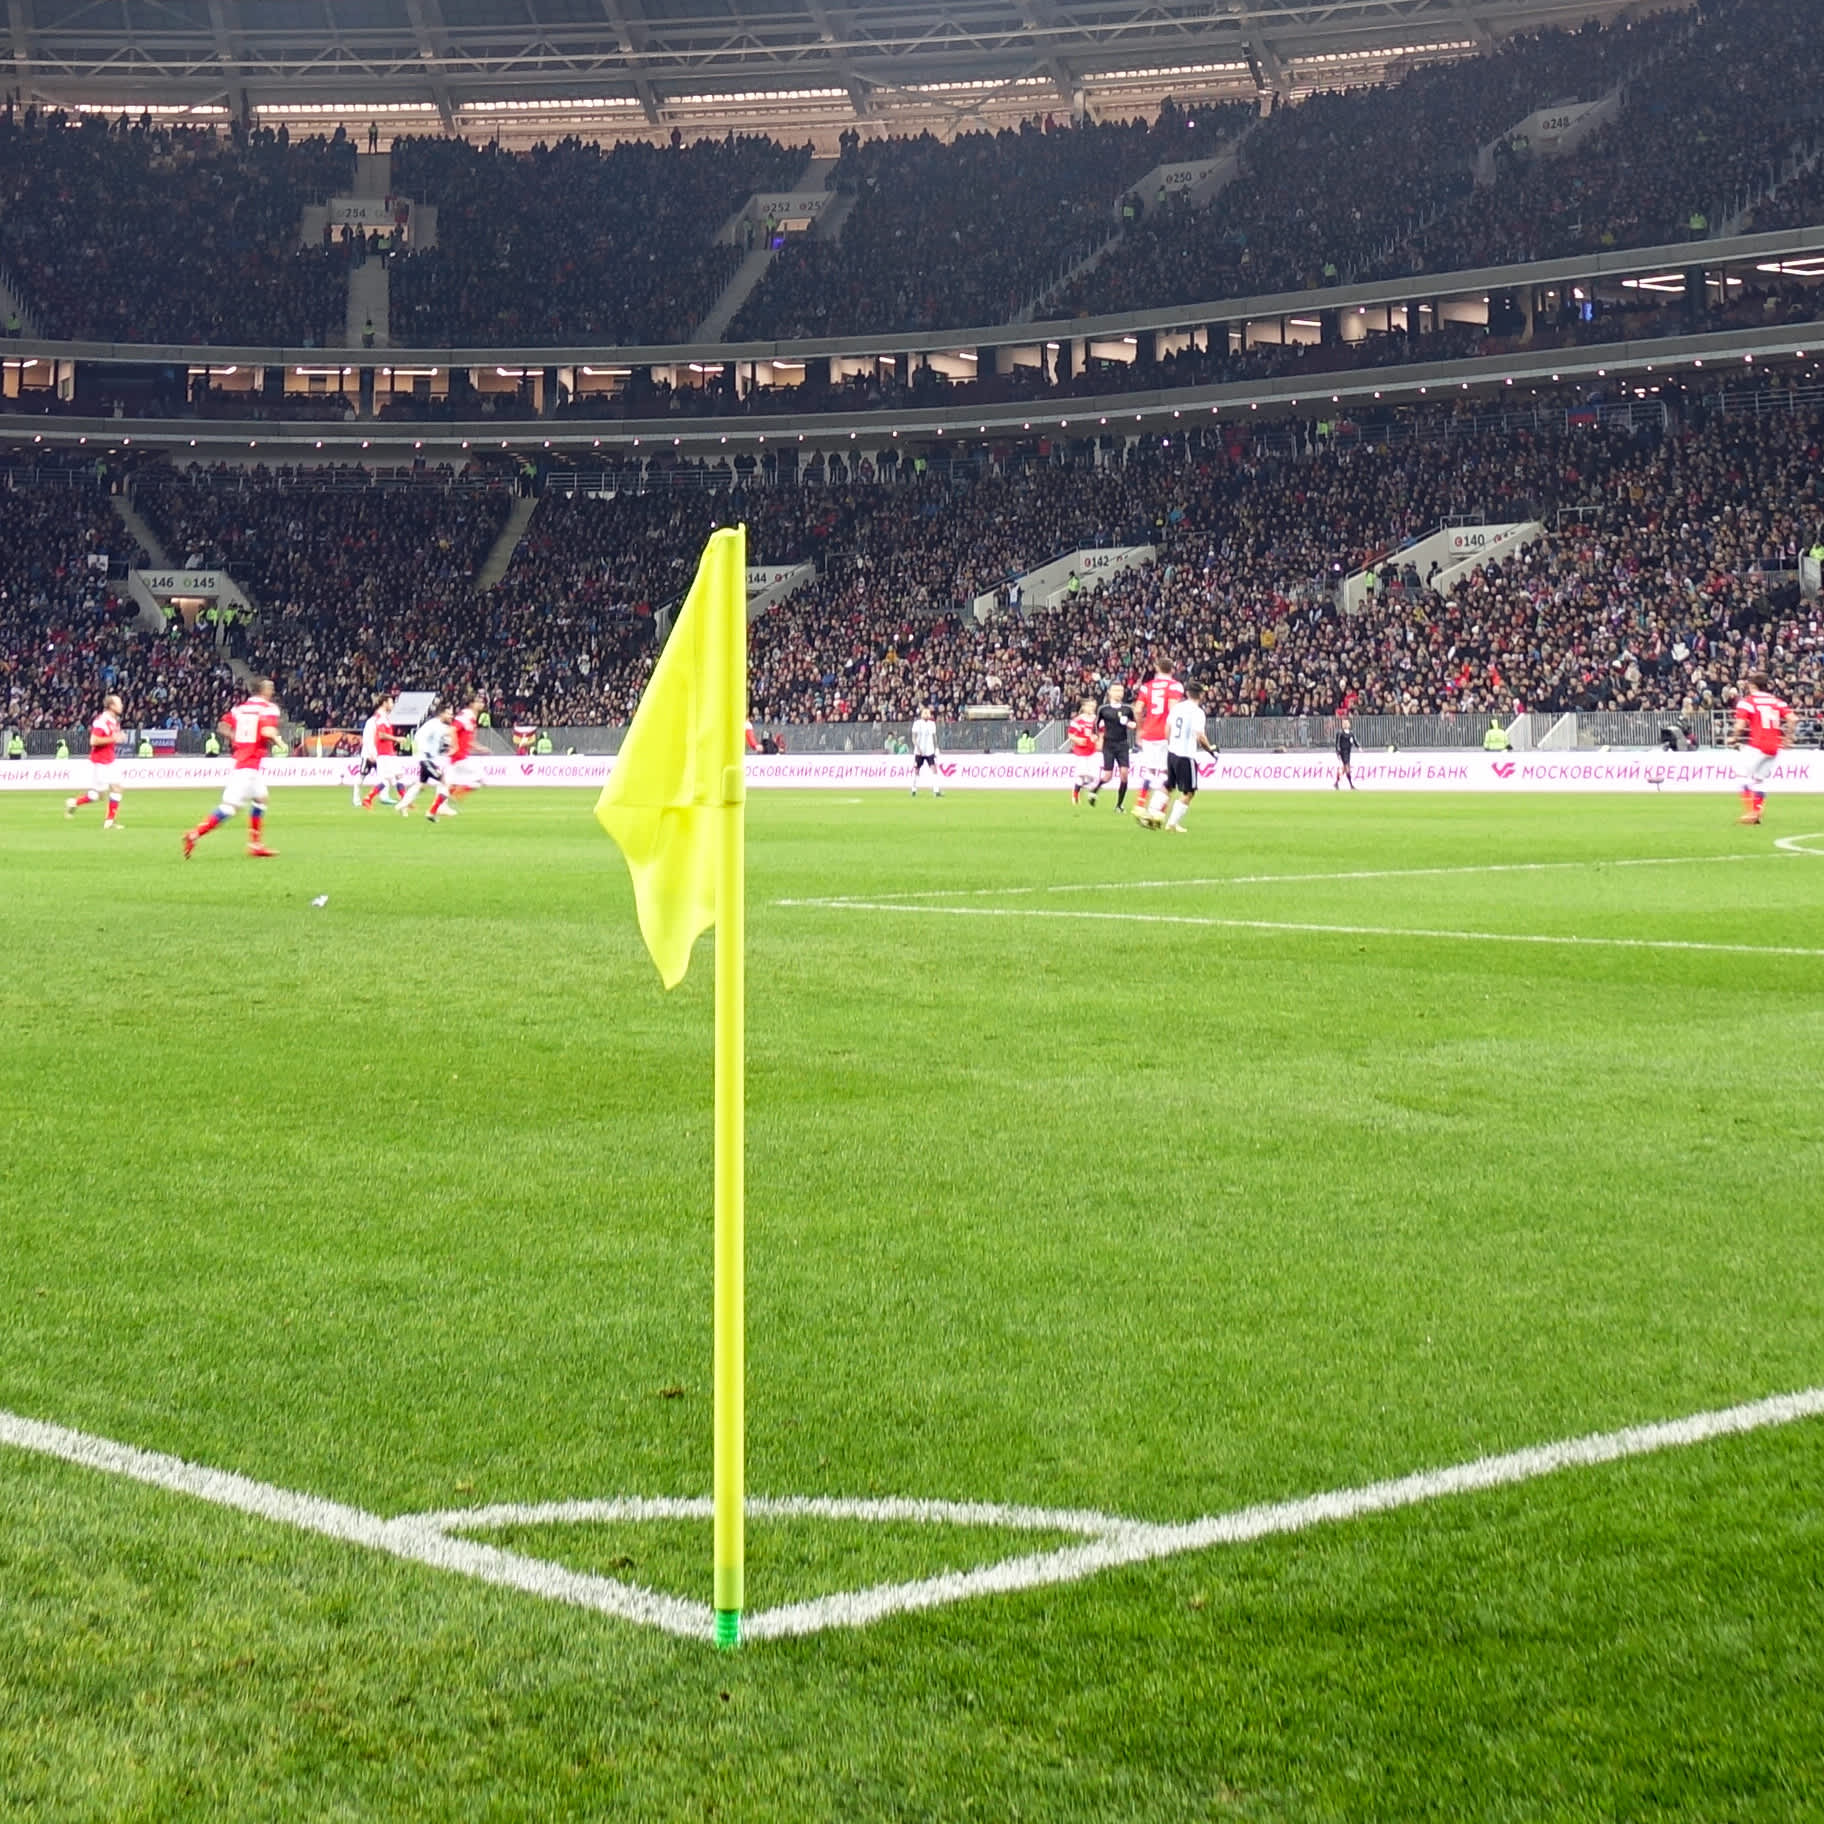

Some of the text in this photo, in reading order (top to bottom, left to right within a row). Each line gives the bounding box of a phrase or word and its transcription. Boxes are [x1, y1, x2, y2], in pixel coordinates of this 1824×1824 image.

[345, 208, 366, 219] 254
[770, 202, 790, 213] 252
[1463, 534, 1485, 547] 140
[1091, 556, 1110, 568] 142
[151, 577, 174, 589] 146
[192, 577, 215, 589] 145
[747, 572, 767, 584] 144
[1150, 688, 1165, 715] 5
[1175, 716, 1184, 738] 9
[32, 768, 71, 781] БАНК
[537, 761, 606, 778] МОСКОВСКИЙ
[745, 762, 812, 779] ОСКОВСКИЙ
[813, 761, 887, 780] КРЕДИТНЫЙ
[961, 761, 1046, 779] МОСКОВСКИЙ
[1221, 760, 1323, 779] МОСКОВСКИЙ
[1427, 765, 1468, 779] БАНК
[1522, 760, 1640, 780] МОСКОВСКИЙ
